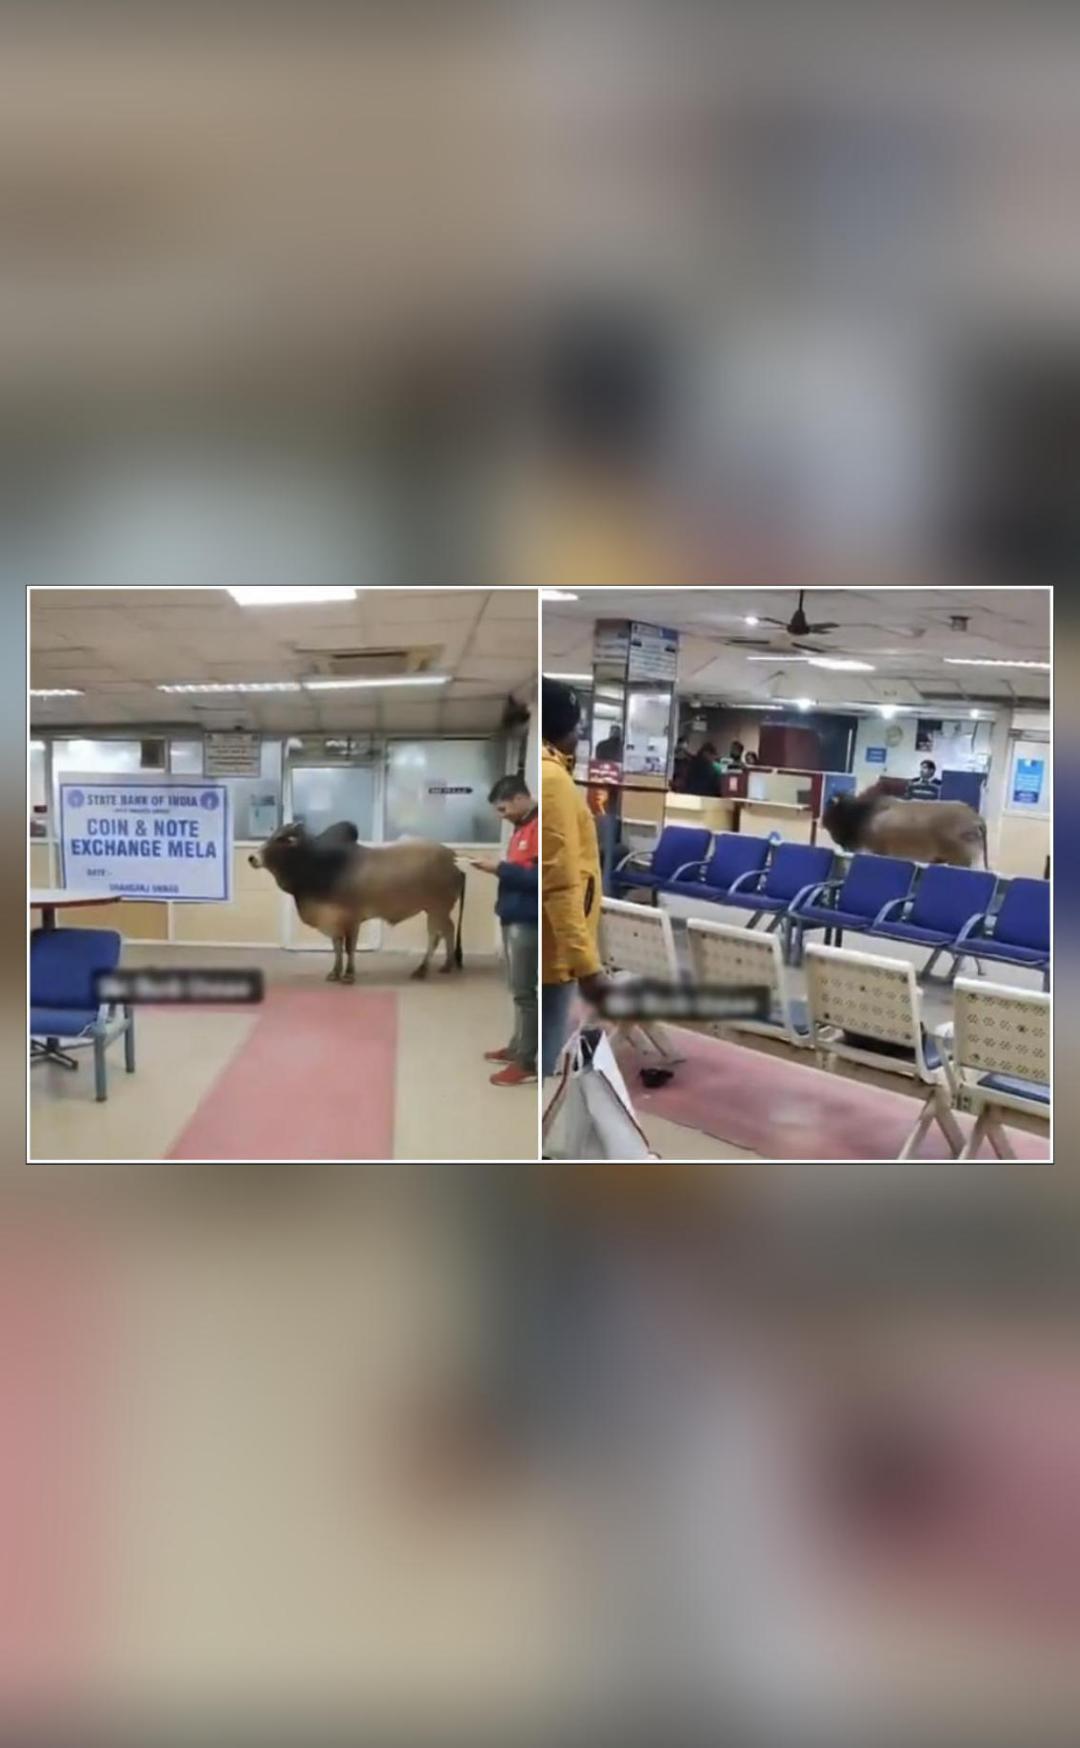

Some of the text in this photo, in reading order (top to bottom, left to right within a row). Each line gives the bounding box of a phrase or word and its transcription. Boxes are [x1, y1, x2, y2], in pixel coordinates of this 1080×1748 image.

[87, 794, 199, 807] STATE BANK OF INDIA
[87, 818, 199, 837] COIN & NOTE
[71, 839, 217, 858] EXCHANGE MELA
